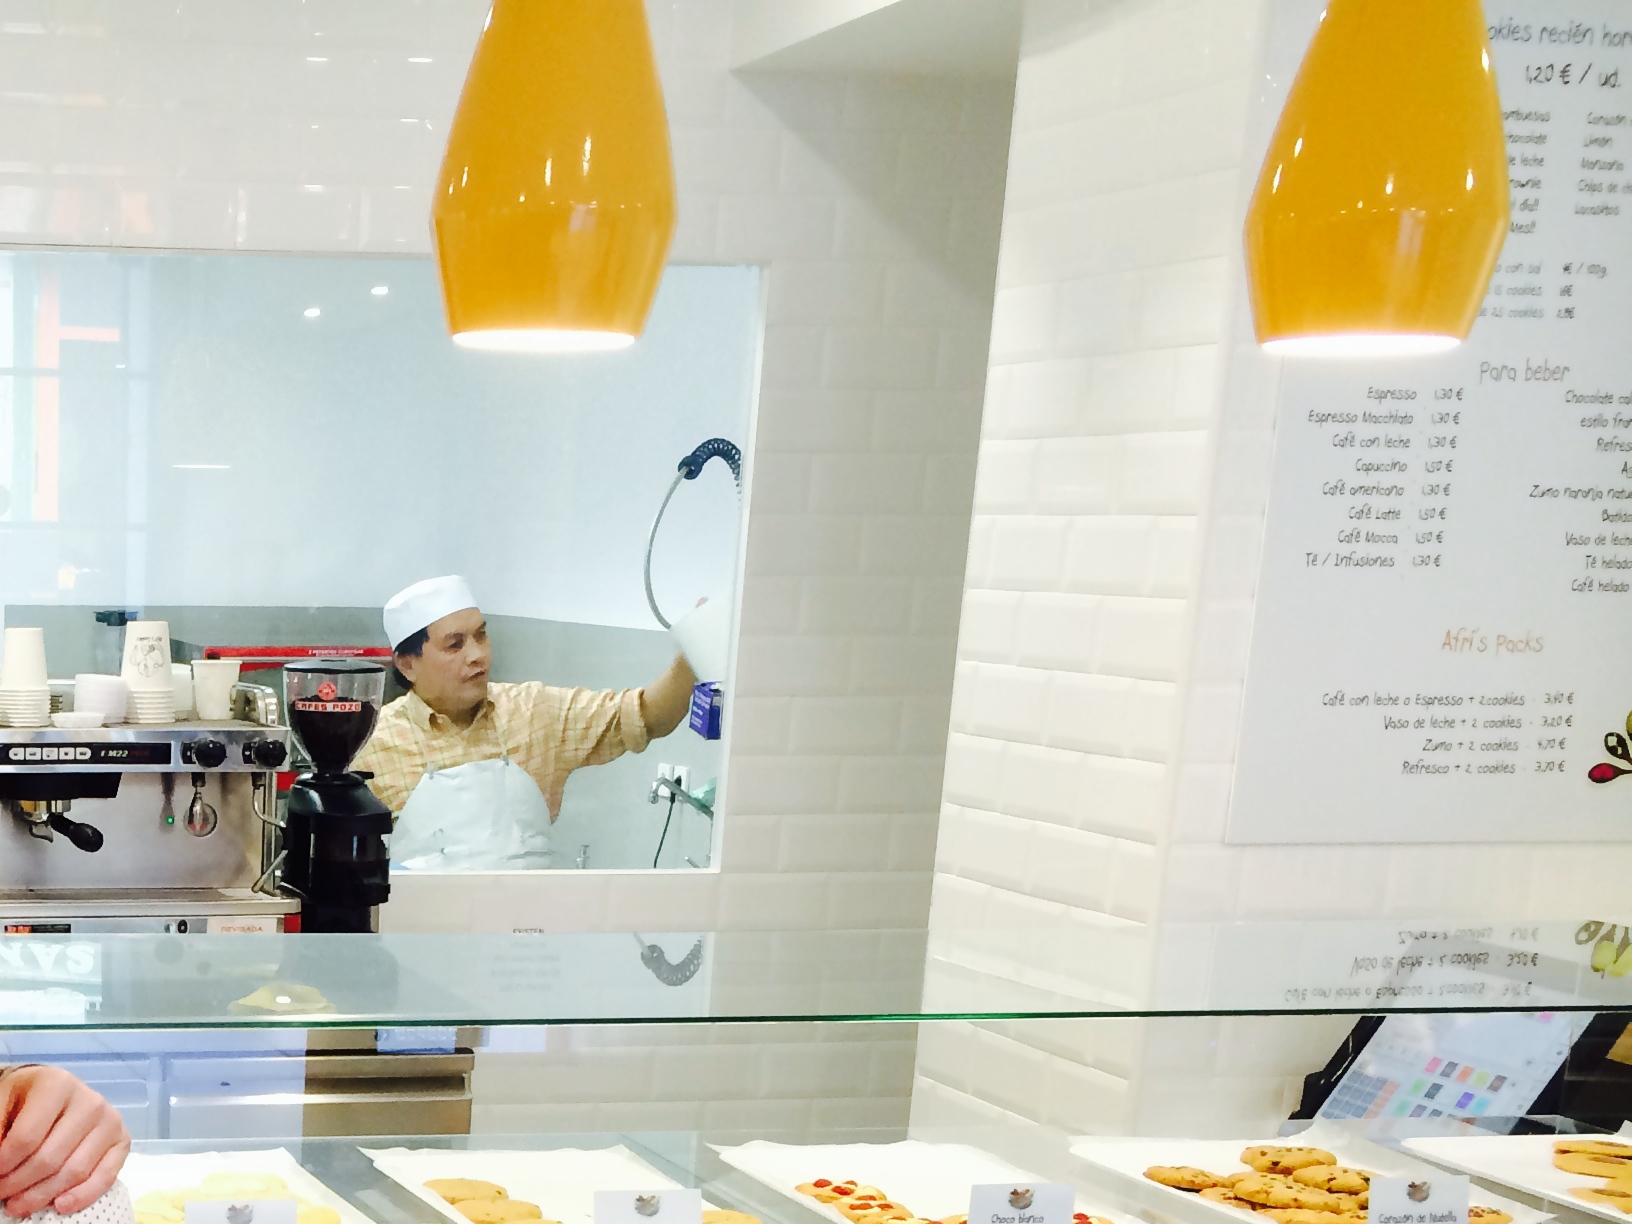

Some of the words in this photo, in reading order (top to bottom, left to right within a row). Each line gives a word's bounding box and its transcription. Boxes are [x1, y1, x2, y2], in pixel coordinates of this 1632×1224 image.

[1488, 17, 1532, 42] okies
[1540, 20, 1593, 45] recién
[1602, 23, 1632, 47] hor
[1526, 63, 1554, 84] 1,20
[1559, 63, 1571, 84] €
[1480, 361, 1517, 385] Para
[1524, 358, 1570, 382] beber
[1367, 387, 1417, 404] Espresso
[1456, 387, 1463, 401] €
[1308, 409, 1358, 428] Espresso
[1362, 410, 1414, 424] Macchiato
[1452, 411, 1461, 425] €
[1332, 431, 1356, 448] Café
[1360, 436, 1380, 448] con
[1384, 433, 1411, 448] leche
[1449, 435, 1457, 449] €
[1445, 459, 1453, 473] €
[1322, 479, 1345, 496] Café
[1349, 481, 1404, 497] americano
[1442, 483, 1451, 497] €
[1529, 485, 1560, 498] Zumo
[1348, 503, 1372, 520] Café
[1375, 507, 1401, 520] Latte
[1438, 507, 1447, 520] €
[1337, 527, 1361, 544] Café
[1365, 530, 1398, 544] Mocca
[1435, 531, 1444, 544] €
[1565, 531, 1591, 546] Vaso
[1594, 534, 1606, 546] de
[1334, 551, 1395, 568] Infusiones
[1433, 554, 1442, 568] €
[1571, 576, 1594, 592] Café
[1495, 630, 1544, 657] Packs
[295, 702, 327, 711] CAFES
[332, 703, 361, 711] POZO
[1323, 690, 1345, 706] Café
[1349, 695, 1369, 706] con
[1374, 692, 1400, 706] leche
[1415, 693, 1464, 710] Espresso
[1384, 715, 1409, 730] Vaso
[1413, 717, 1425, 729] de
[1430, 714, 1456, 729] leche
[1483, 715, 1522, 729] cookies
[1422, 739, 1452, 752] Zumo
[1480, 738, 1519, 752] cookies
[1402, 759, 1450, 774] Refresco
[1477, 760, 1516, 774] cookies
[991, 1213, 1016, 1224] Choco
[1416, 1214, 1426, 1223] de
